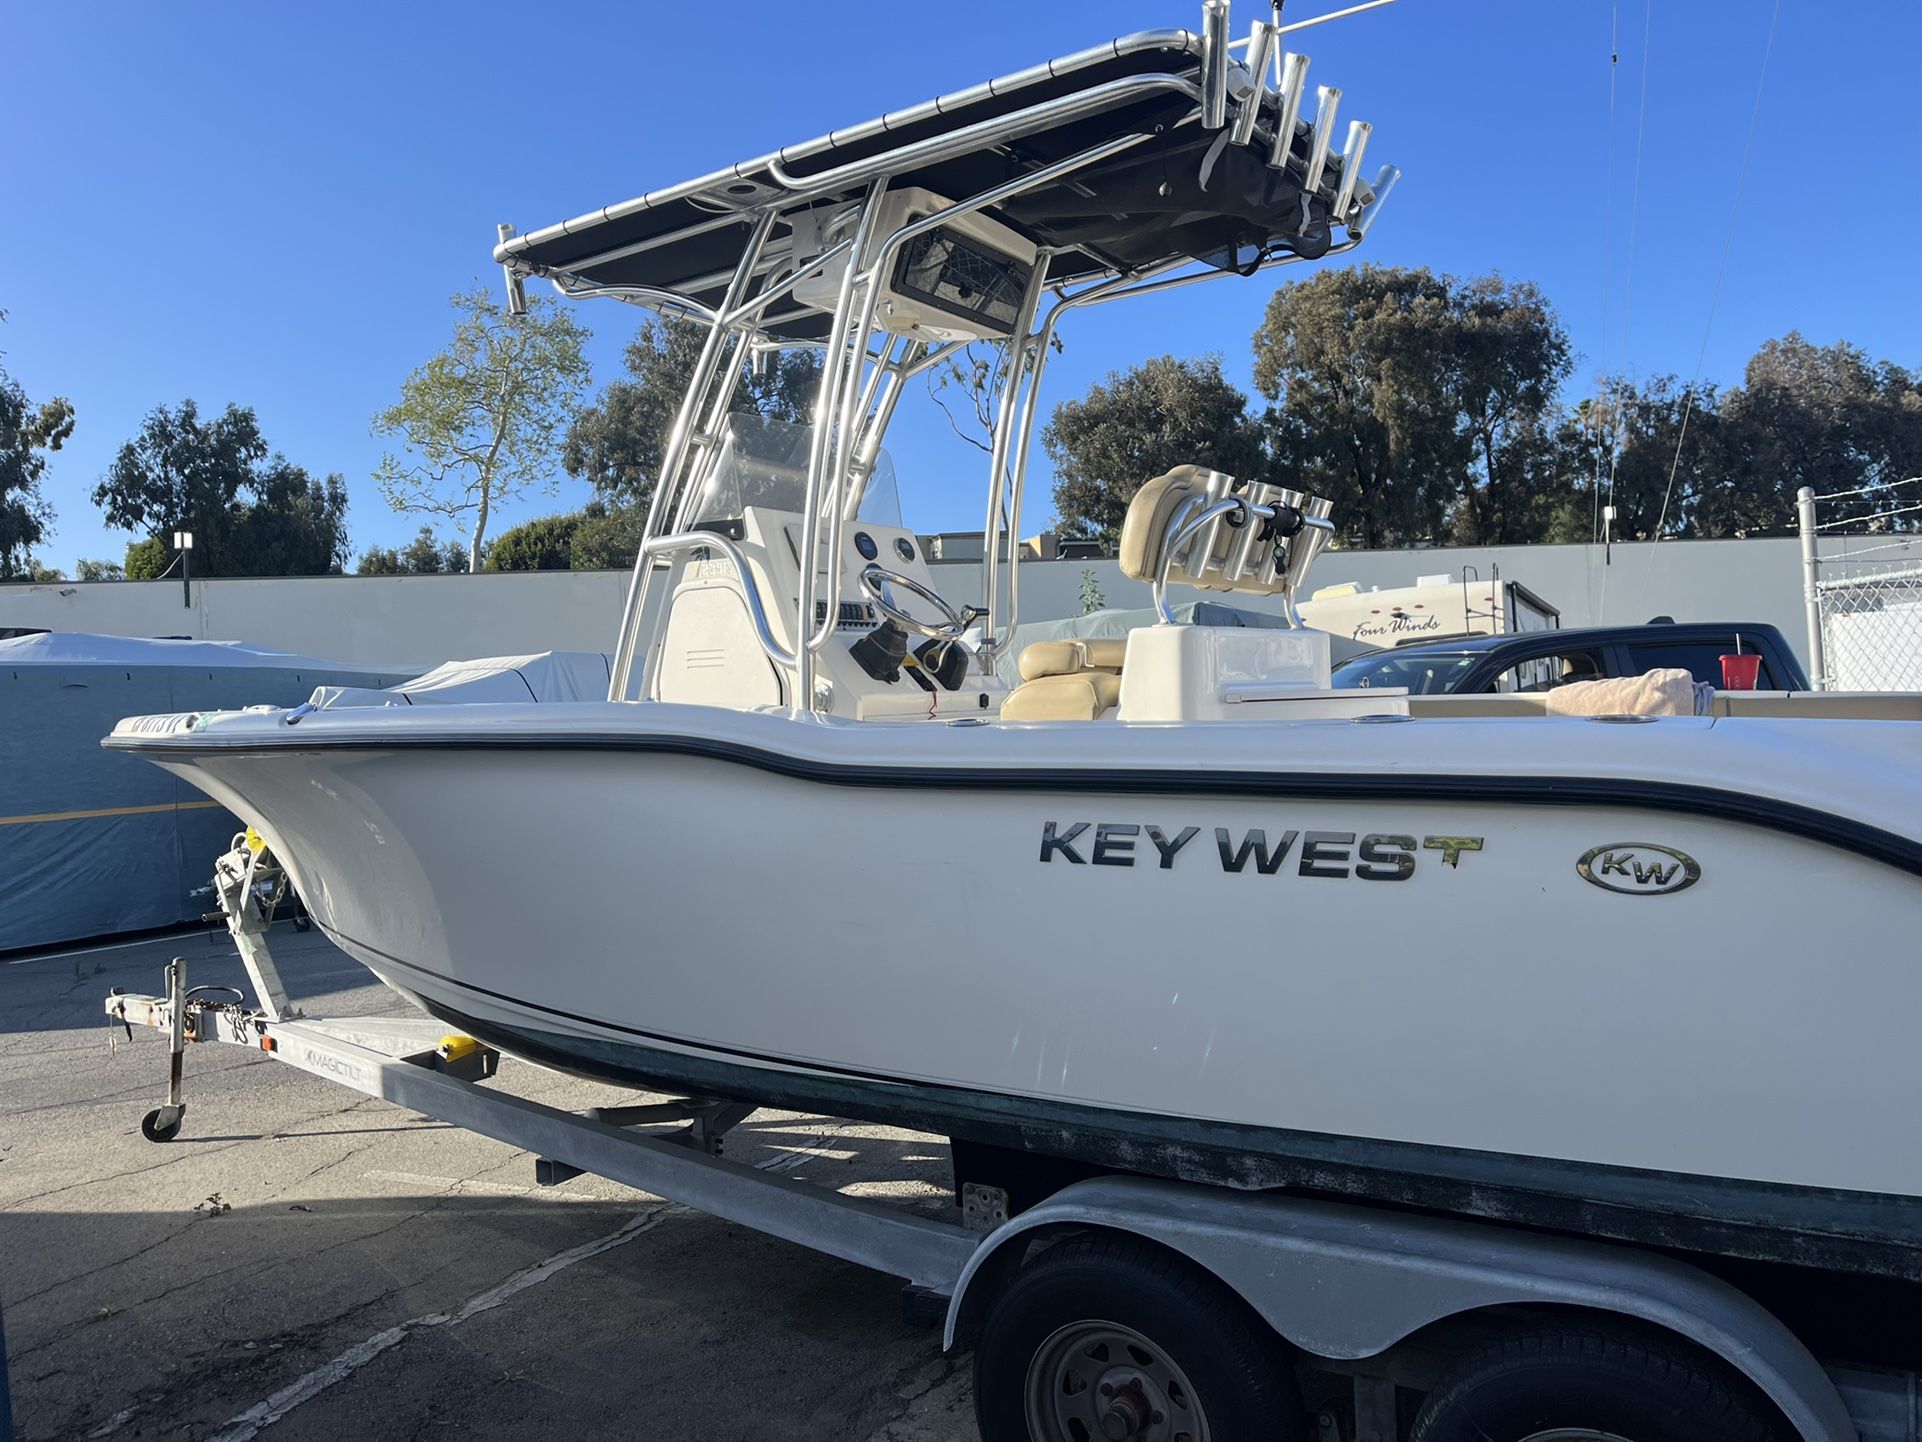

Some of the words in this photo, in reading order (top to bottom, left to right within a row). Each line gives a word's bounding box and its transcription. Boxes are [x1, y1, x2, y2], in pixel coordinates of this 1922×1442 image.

[1353, 621, 1387, 640] Four
[1389, 614, 1441, 633] Winds
[1039, 821, 1201, 870] KEY
[1214, 827, 1484, 882] WEST
[1601, 852, 1680, 885] KW
